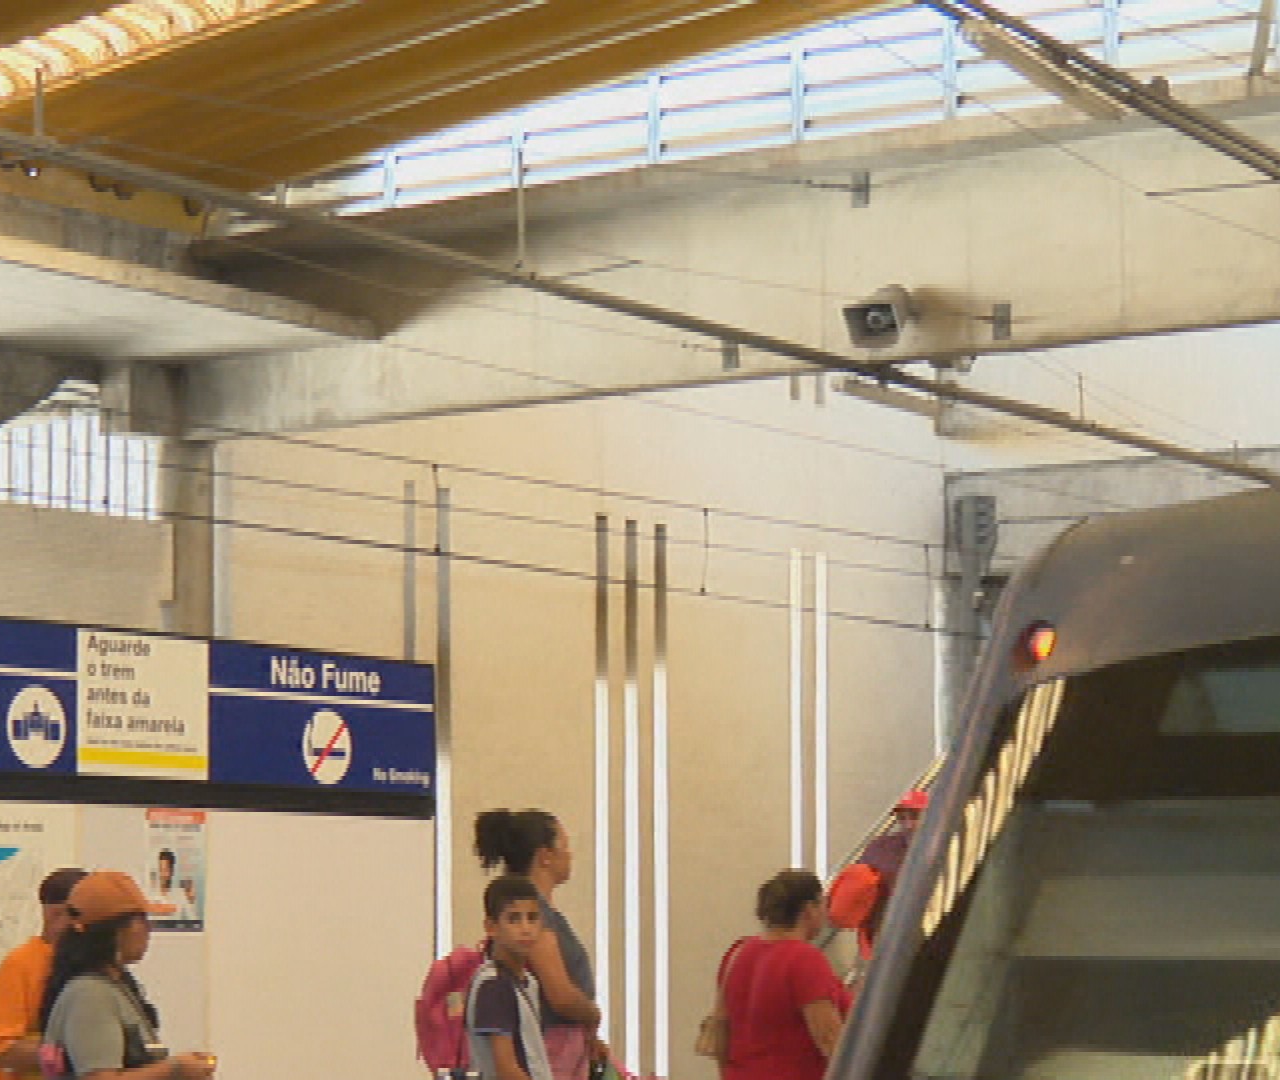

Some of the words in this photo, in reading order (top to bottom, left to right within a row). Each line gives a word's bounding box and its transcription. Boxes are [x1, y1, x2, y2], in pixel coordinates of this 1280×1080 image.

[87, 634, 151, 656] Aguarde
[86, 663, 96, 677] o
[101, 660, 135, 680] trem
[271, 655, 317, 689] Não
[321, 660, 381, 696] Fume
[87, 687, 128, 705] antes
[87, 708, 122, 729] faixa
[127, 715, 185, 736] amarela
